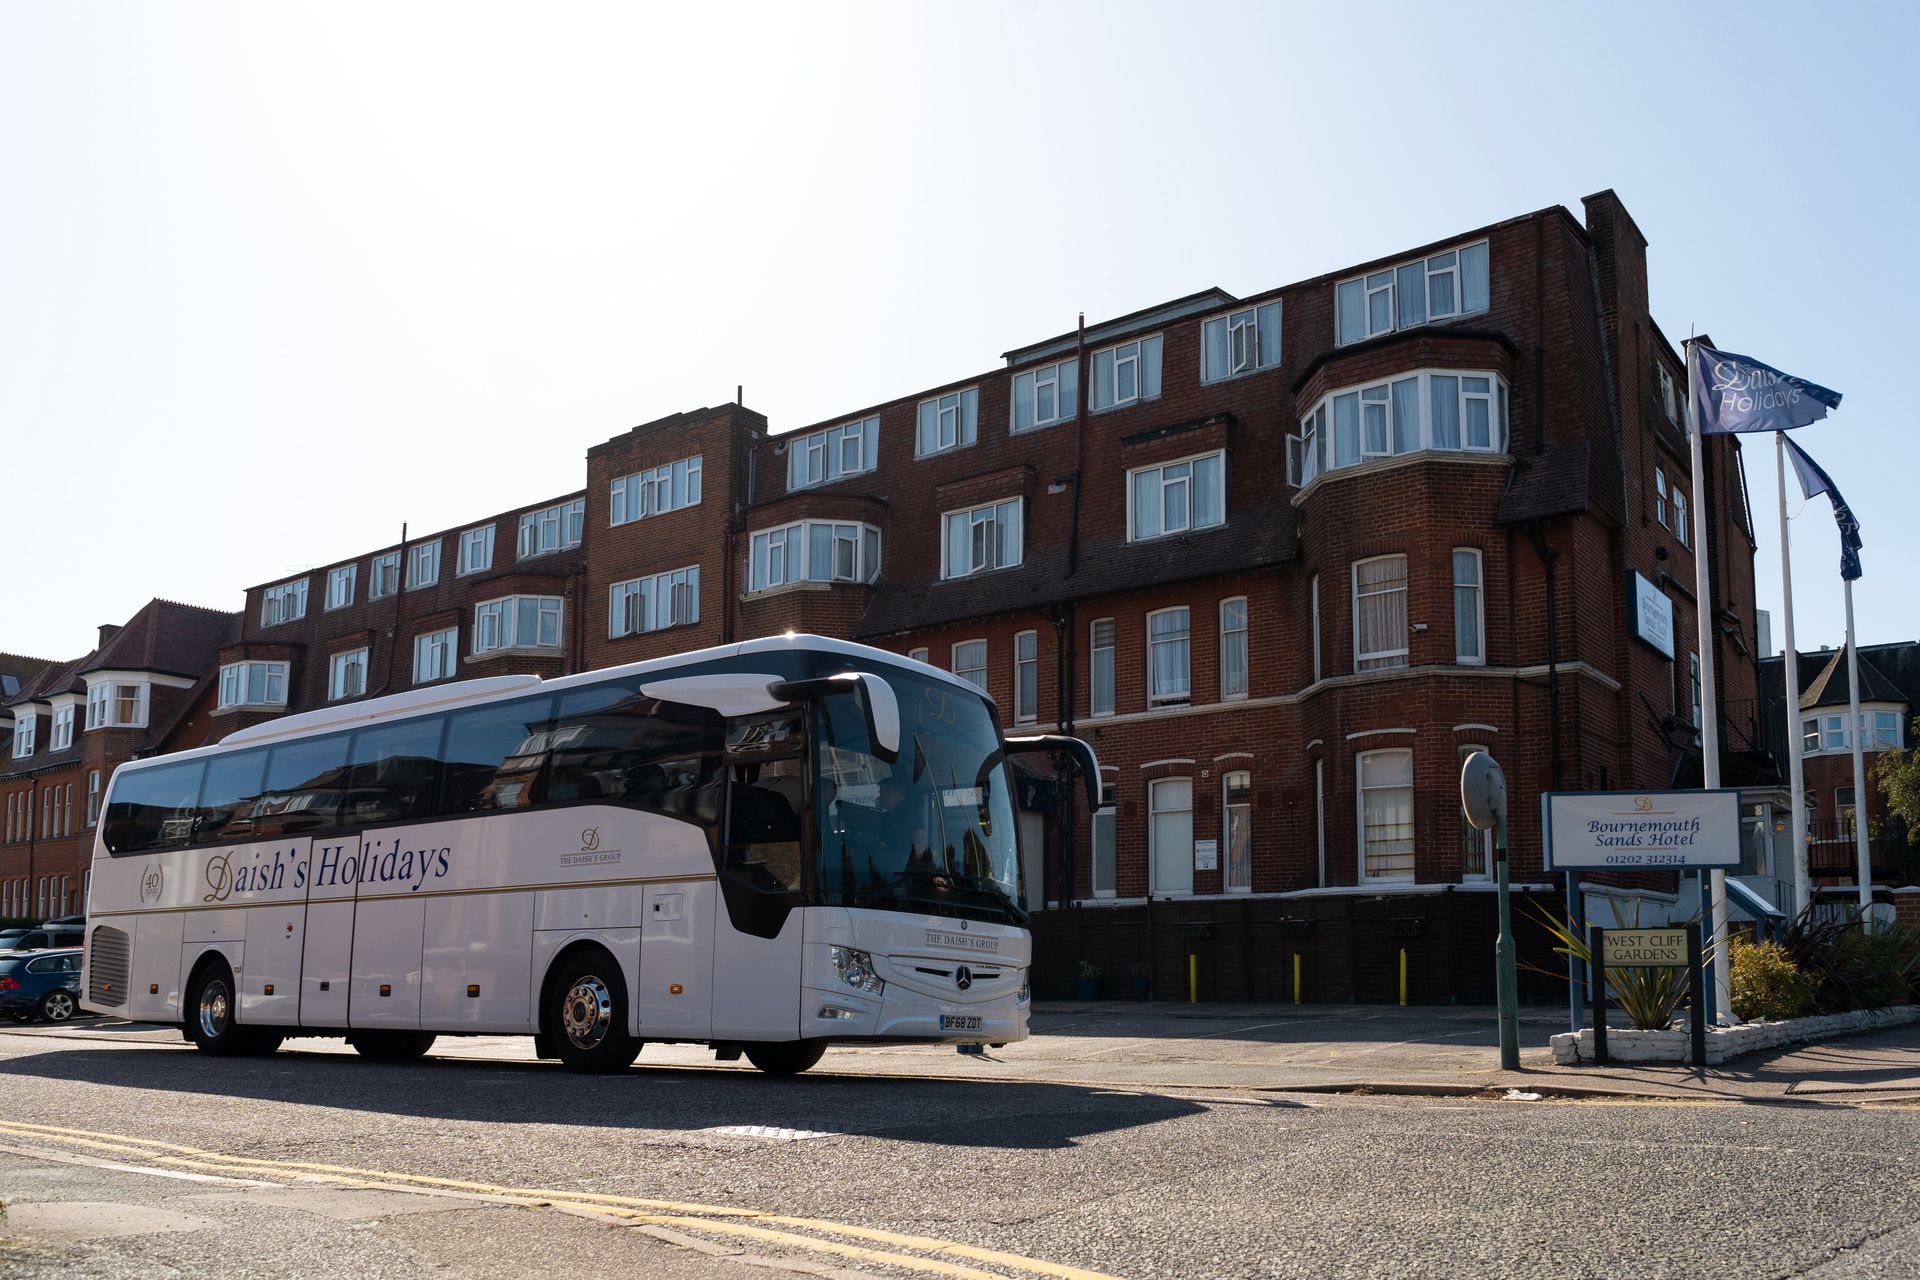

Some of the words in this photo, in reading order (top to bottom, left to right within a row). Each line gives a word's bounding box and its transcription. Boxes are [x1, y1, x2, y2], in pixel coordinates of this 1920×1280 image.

[1720, 388, 1803, 412] Holidays
[1587, 817, 1701, 833] Bournemouth
[1595, 832, 1642, 847] Sands
[1647, 831, 1695, 846] Hotel
[560, 857, 572, 865] THE
[573, 854, 598, 864] DAISH'S
[599, 852, 621, 862] GROUP
[1606, 855, 1642, 864] 01202
[1646, 854, 1687, 865] 312314
[203, 848, 308, 903] Daish's
[315, 838, 452, 892] Holidays
[146, 873, 159, 889] 40
[926, 933, 941, 944] THE
[944, 935, 974, 948] DAISH'S
[976, 939, 999, 951] GROUP
[1607, 935, 1644, 947] WEST
[1649, 935, 1684, 947] CLIFF
[1613, 948, 1678, 960] GARDENS
[945, 1016, 966, 1029] BF68
[967, 1016, 982, 1029] ZDT
